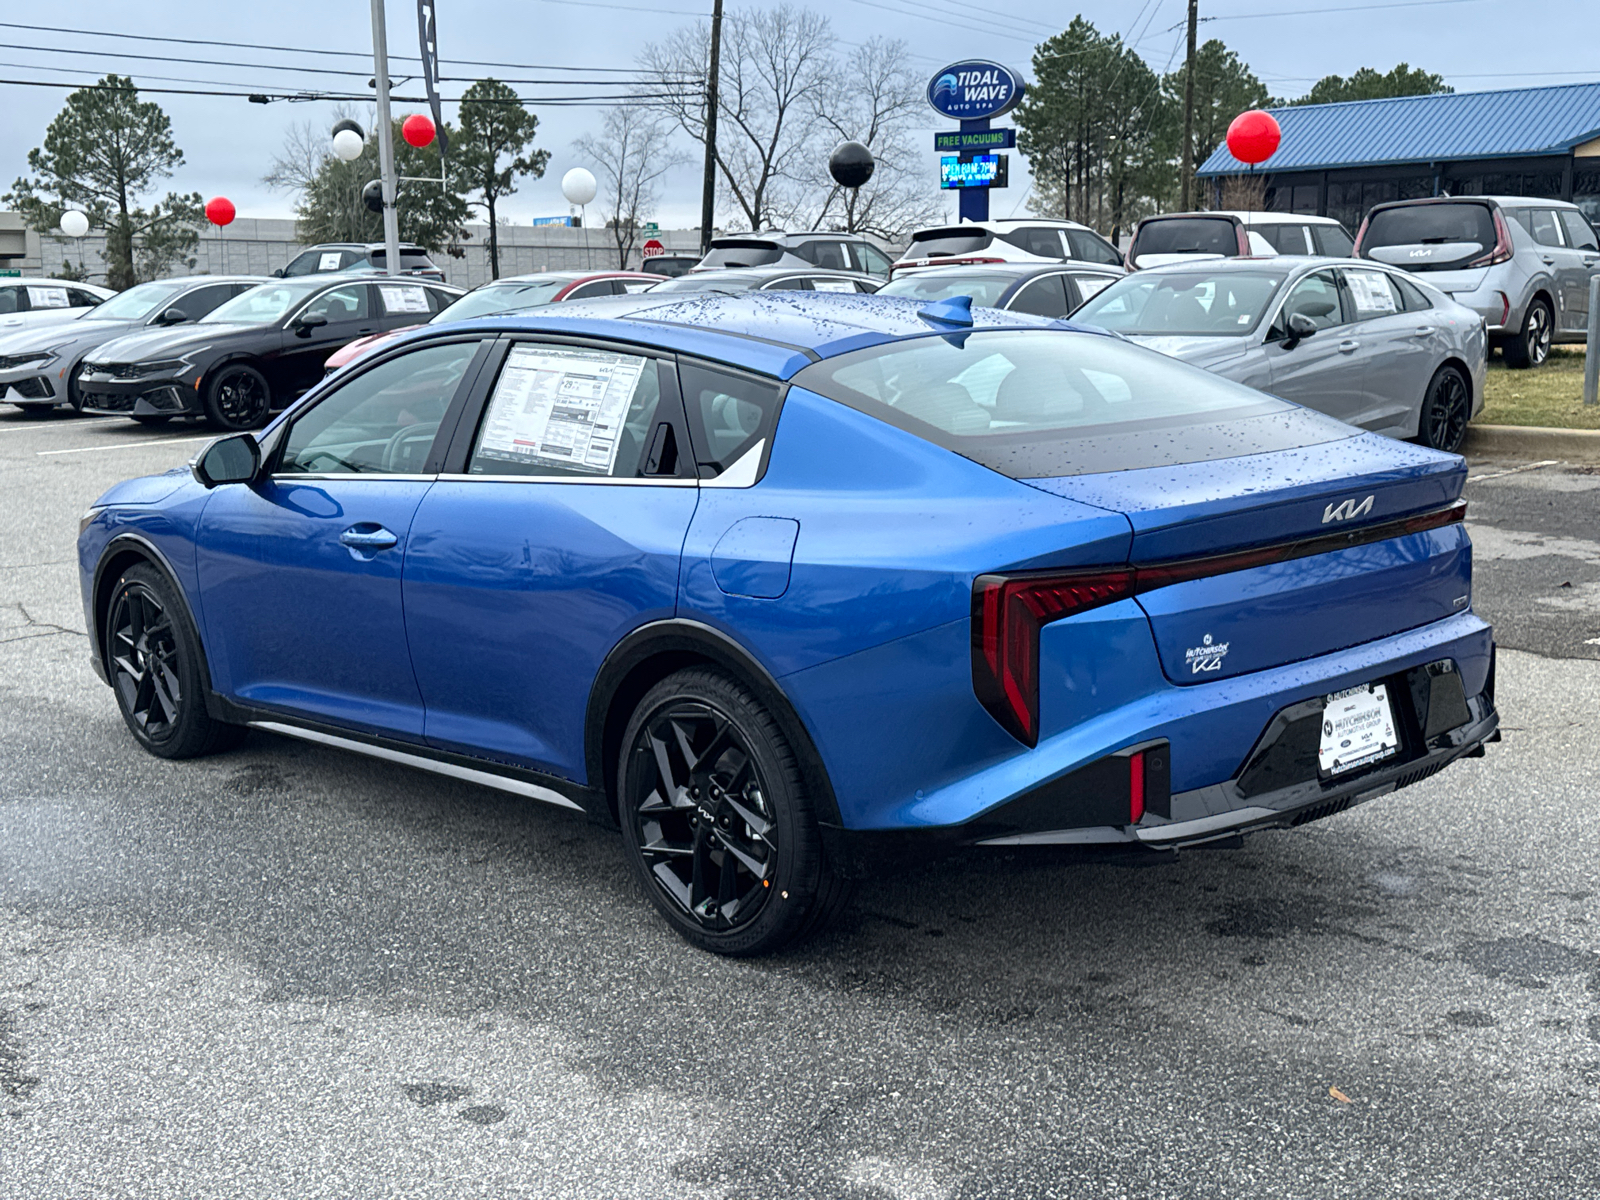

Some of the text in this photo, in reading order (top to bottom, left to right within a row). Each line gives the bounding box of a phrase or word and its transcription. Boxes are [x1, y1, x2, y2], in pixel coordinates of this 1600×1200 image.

[958, 70, 999, 86] TIDAL
[965, 85, 1008, 101] WAVE
[947, 103, 970, 111] AUTO
[938, 132, 1004, 147] FREE VACUUMS
[644, 247, 664, 257] STOP
[1322, 495, 1375, 524] KIA
[1185, 641, 1229, 658] HUTCHINSON
[1192, 657, 1221, 674] K4
[1334, 682, 1370, 701] HUTCHINSON
[1335, 707, 1382, 731] HUTCHINSON
[1338, 718, 1382, 738] AUTOMOTIVE GROUP
